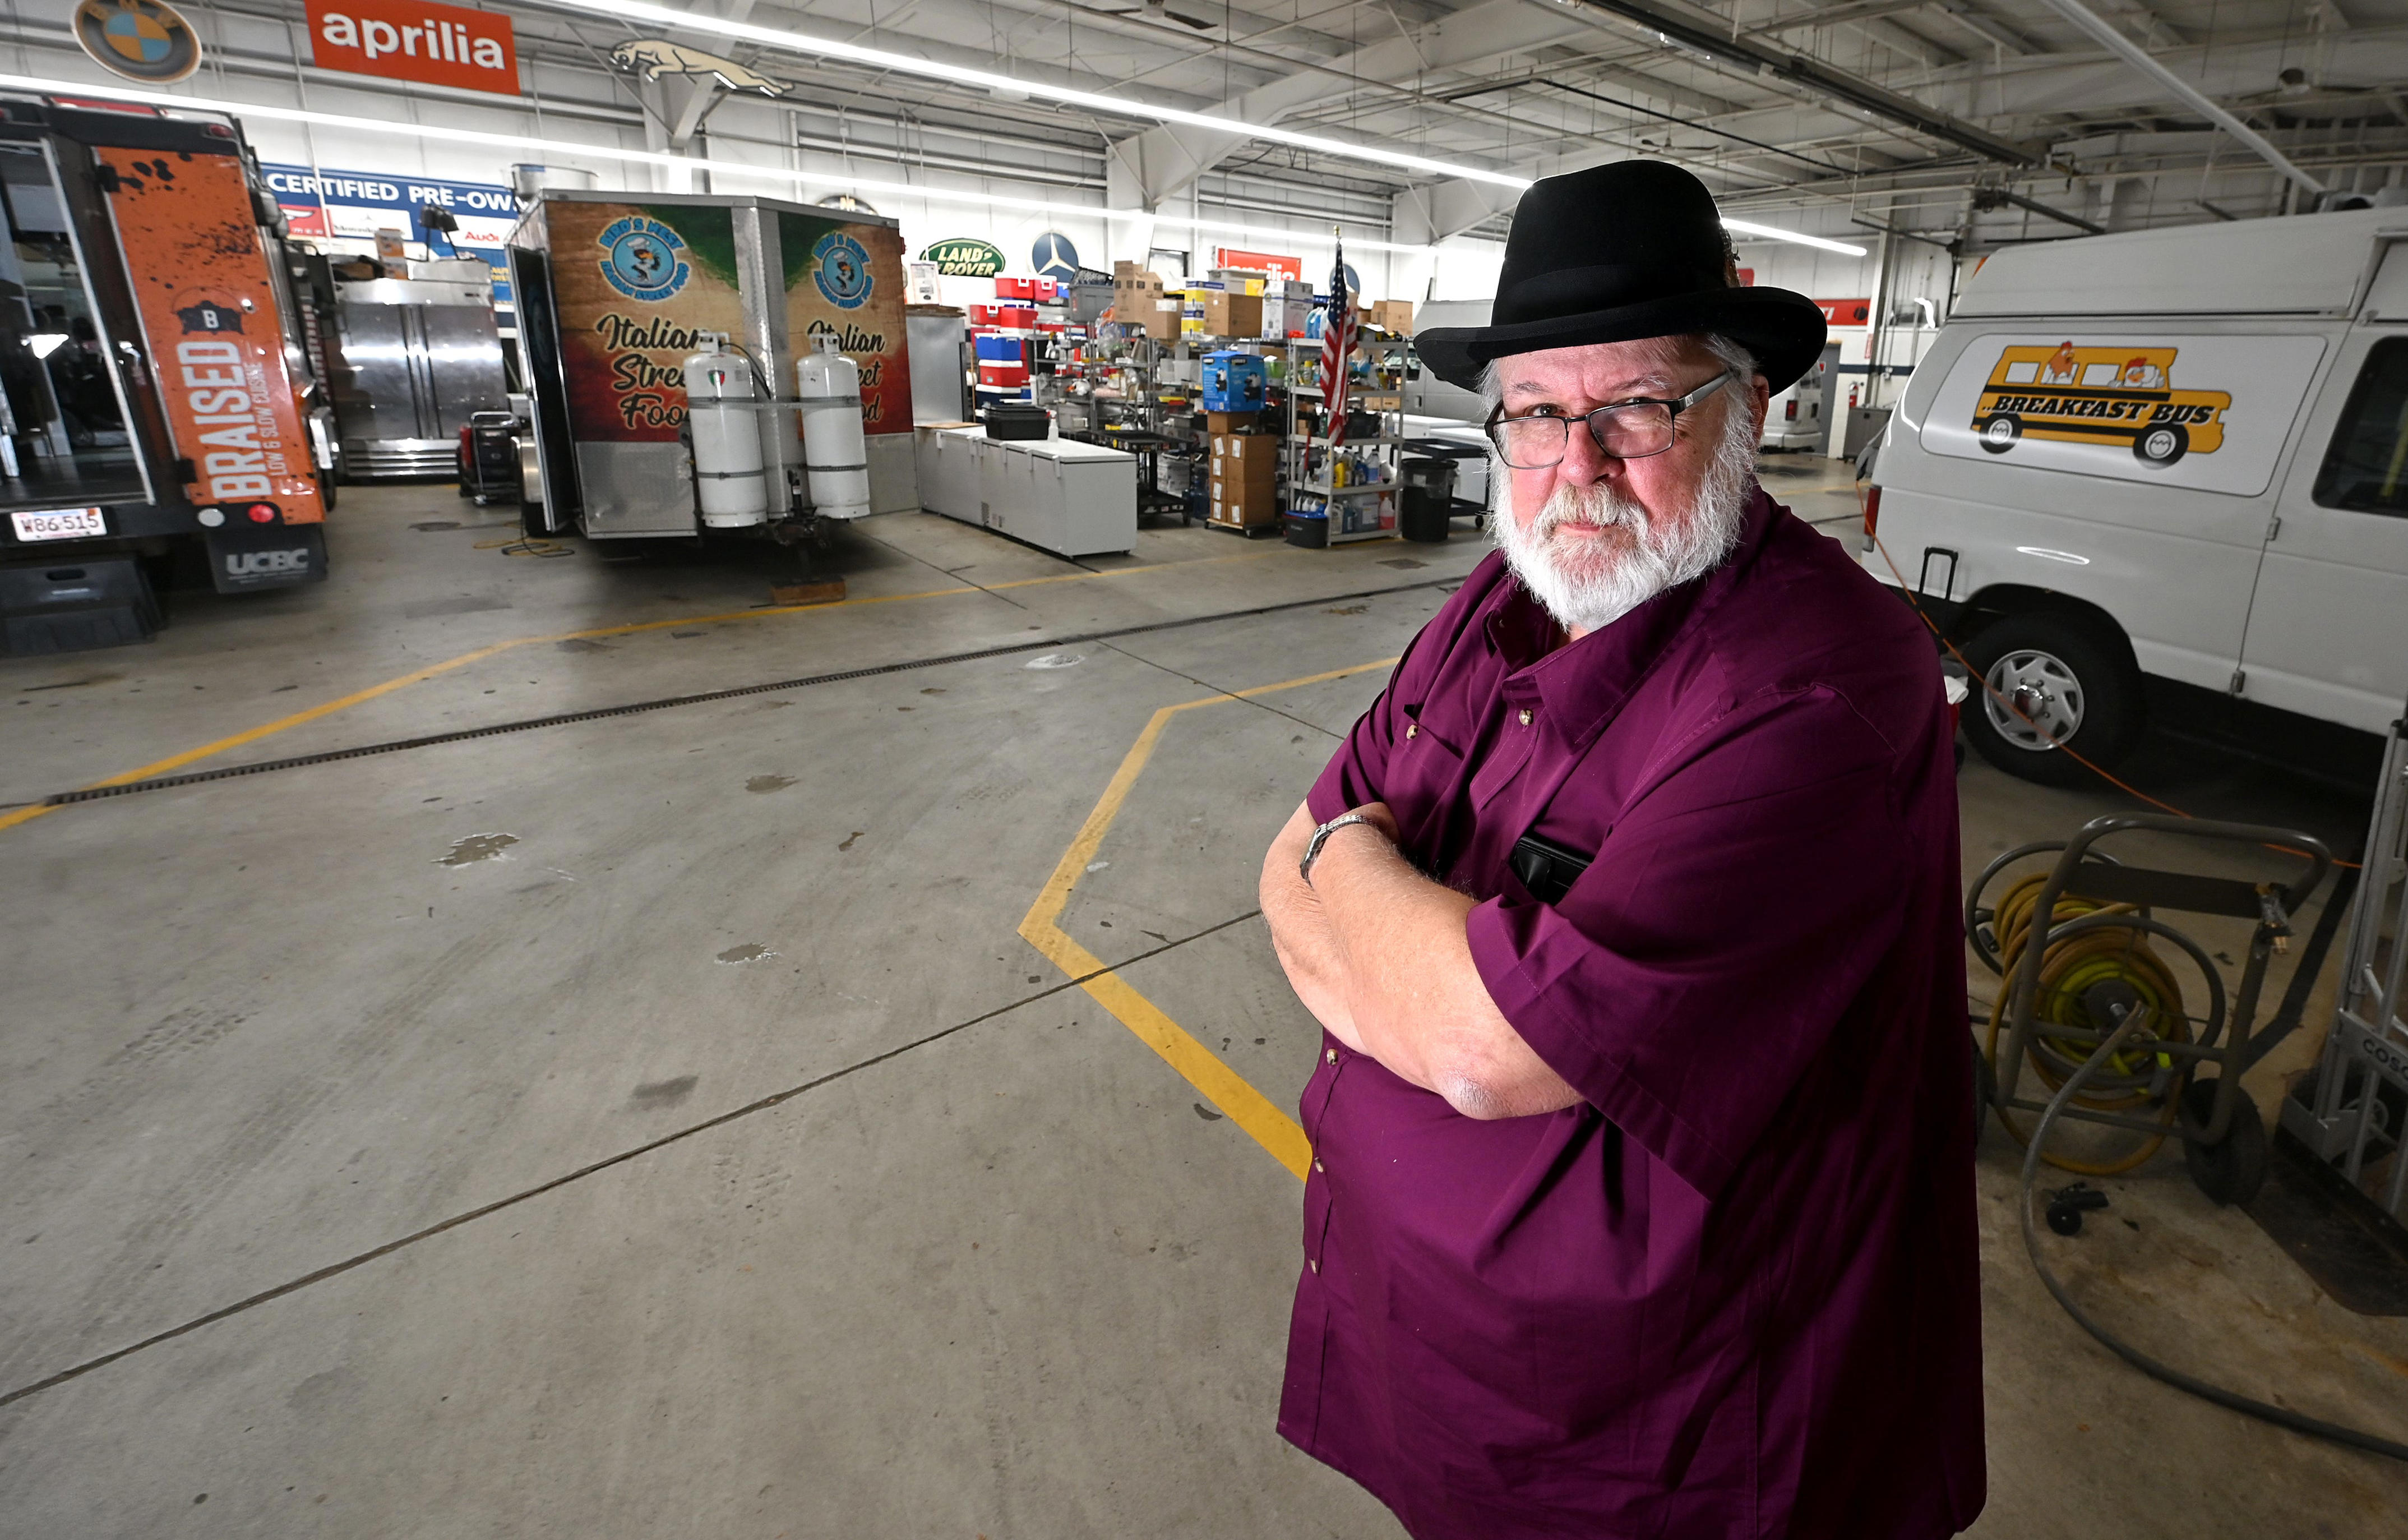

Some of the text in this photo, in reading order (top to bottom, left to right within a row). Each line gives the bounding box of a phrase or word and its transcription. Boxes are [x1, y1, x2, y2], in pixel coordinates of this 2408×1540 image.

[322, 12, 505, 70] aprilia
[266, 173, 400, 201] CERTIFIED
[465, 231, 500, 242] Audi
[937, 247, 983, 262] LAND
[941, 262, 996, 276] ROVER
[202, 310, 220, 329] B
[613, 353, 686, 391] Stre
[177, 341, 272, 499] BRAISED
[253, 407, 280, 438] SLOW
[620, 393, 690, 428] Foo
[2148, 404, 2216, 426] BUS
[265, 451, 288, 476] LOW
[227, 548, 308, 575] UCBC
